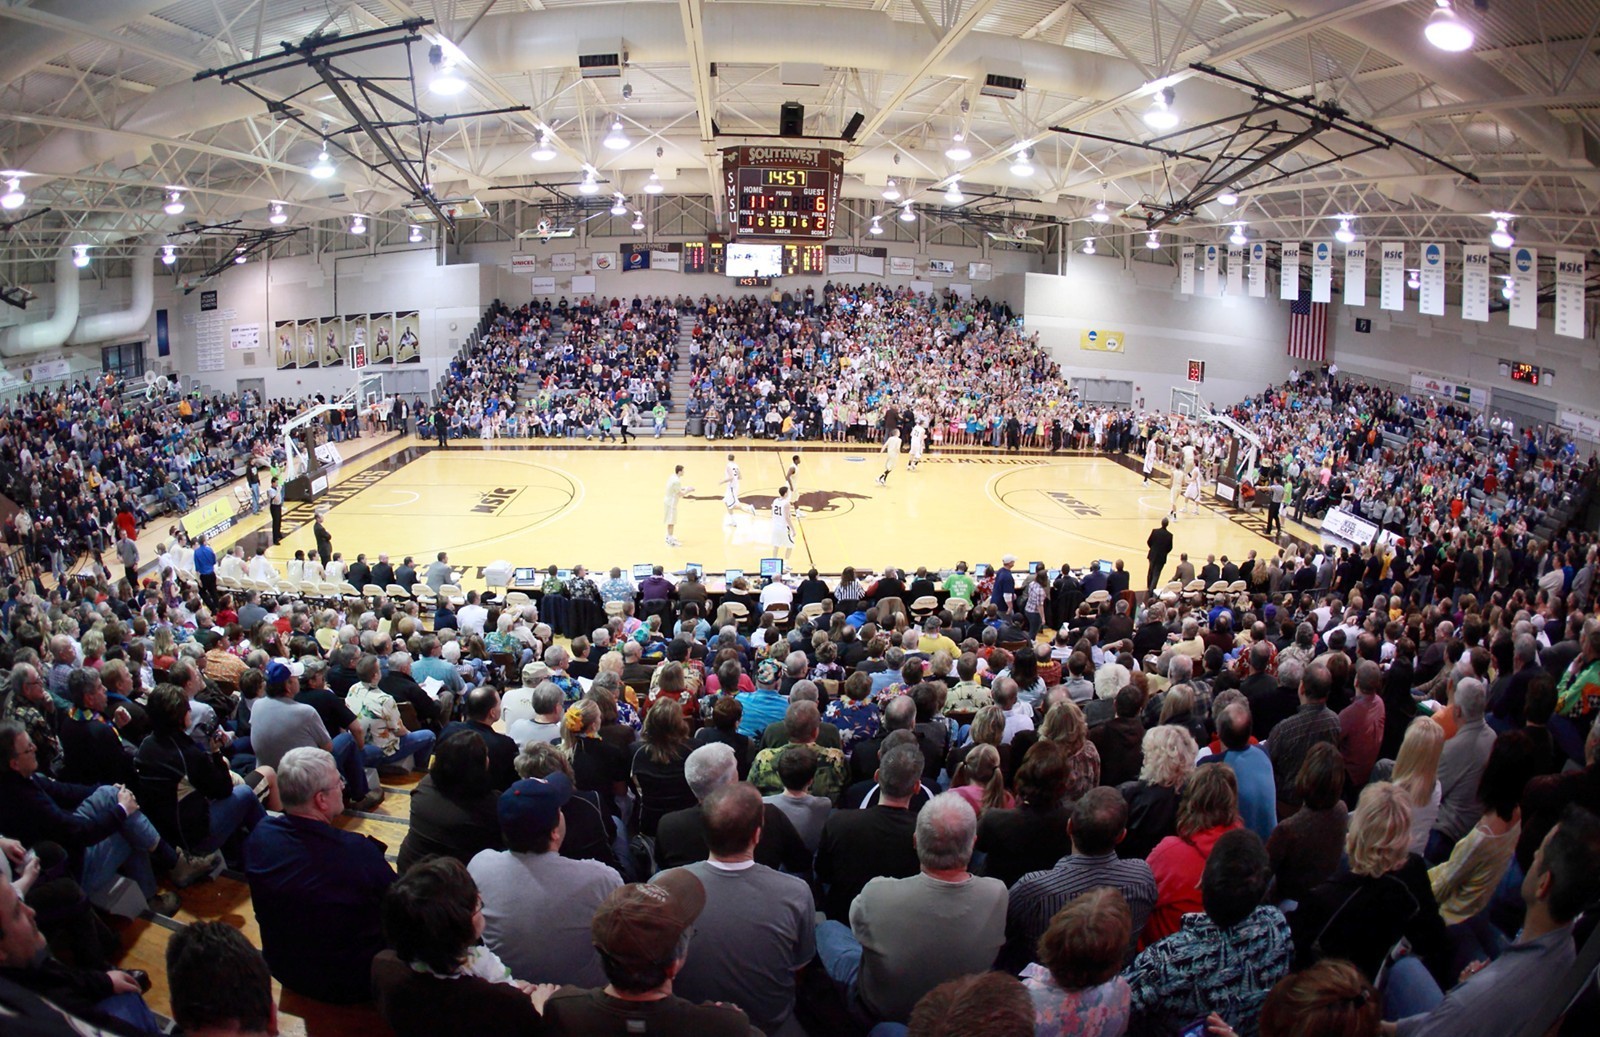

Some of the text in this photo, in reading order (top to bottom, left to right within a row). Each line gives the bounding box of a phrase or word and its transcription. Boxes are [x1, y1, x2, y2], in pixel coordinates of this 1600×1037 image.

[749, 148, 820, 162] SOUTHWEST
[768, 170, 806, 185] 14:57
[743, 186, 763, 194] HOME
[803, 188, 825, 196] GUEST
[727, 172, 737, 223] SMSU
[751, 195, 765, 208] 11
[816, 196, 826, 211] 6
[828, 173, 840, 237] MUSTANGS
[757, 217, 765, 227] 6
[770, 215, 785, 227] 33
[801, 218, 808, 228] 6
[816, 217, 825, 229] 2
[1283, 249, 1298, 257] NSIC
[1347, 249, 1365, 258] NSIC
[1384, 250, 1403, 259] NSIC
[1466, 253, 1487, 264] NSIC
[1559, 261, 1582, 273] NSIC
[470, 487, 517, 513] NSIC
[773, 505, 782, 516] 21
